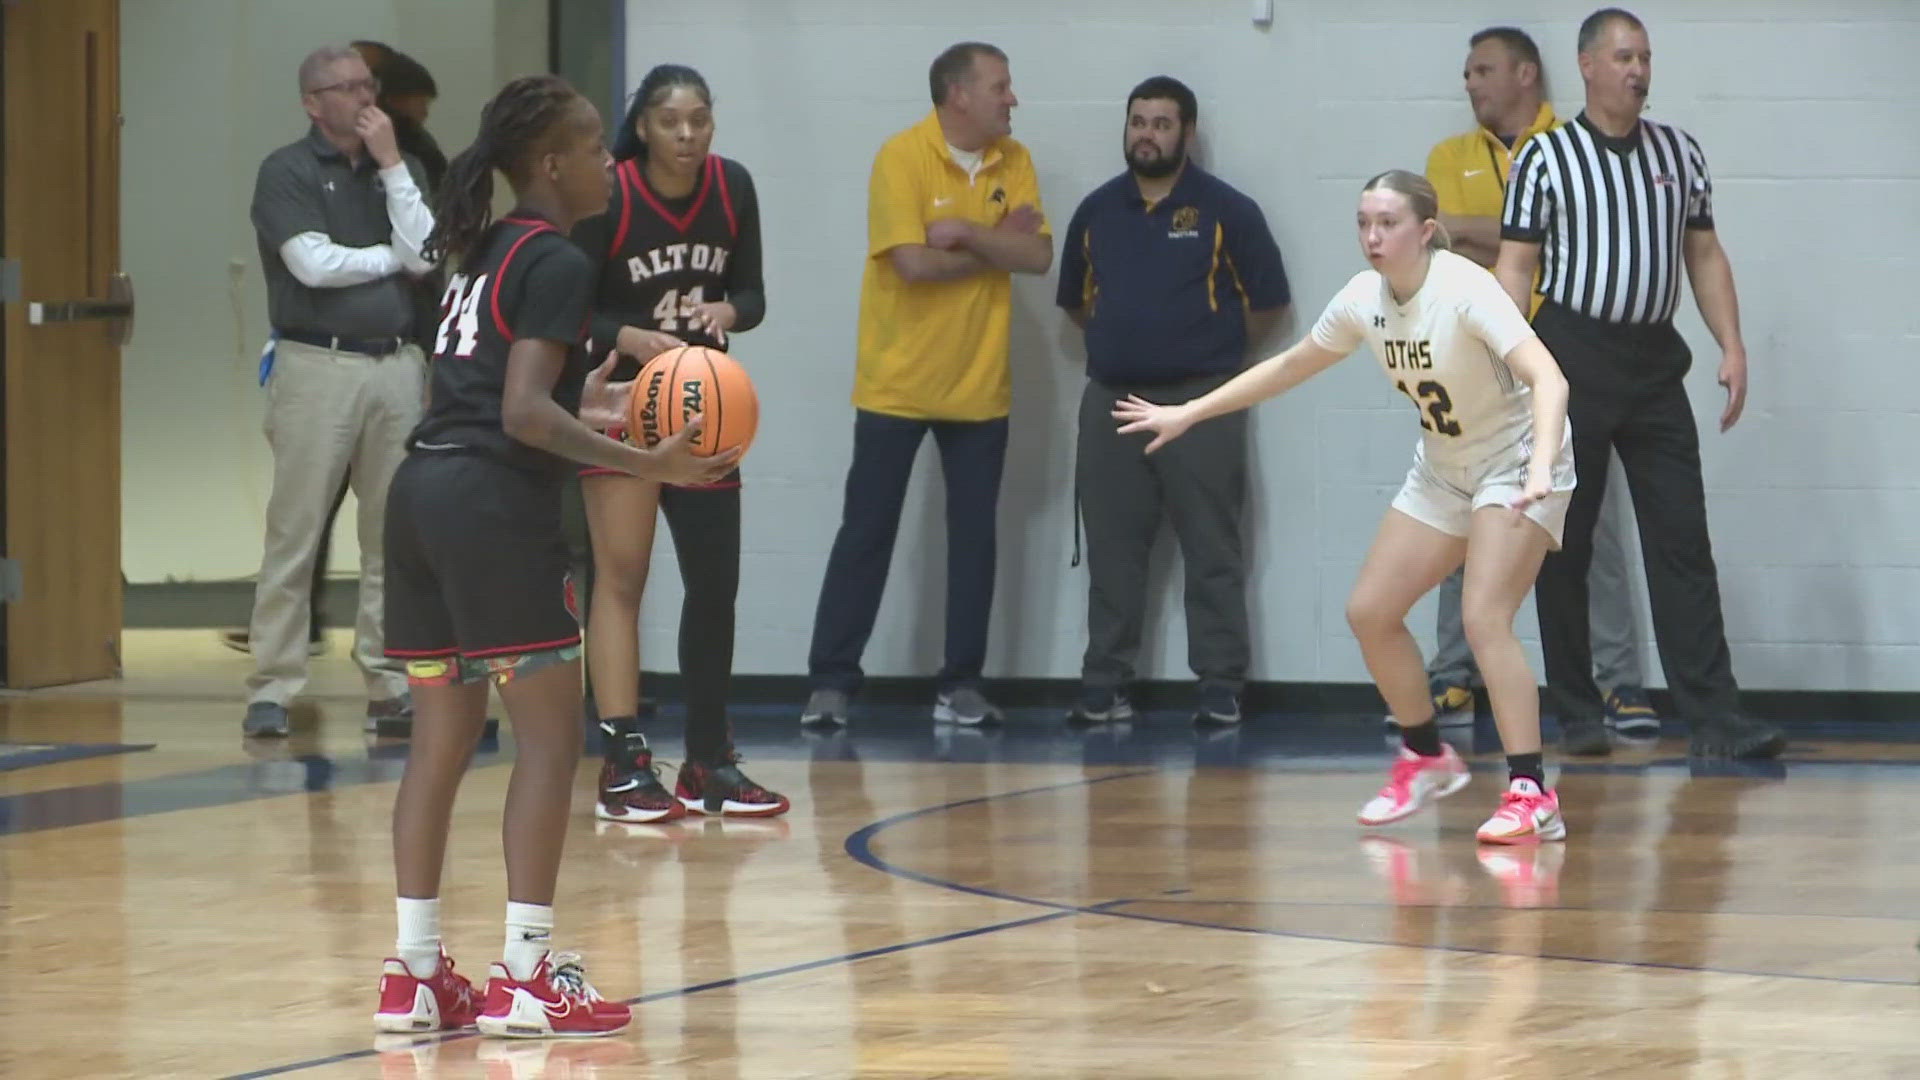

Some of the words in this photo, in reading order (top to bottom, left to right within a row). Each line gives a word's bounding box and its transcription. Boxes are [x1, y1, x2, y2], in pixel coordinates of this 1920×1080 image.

[627, 243, 729, 284] ALTON
[432, 272, 488, 359] 24
[653, 285, 705, 332] 44
[1384, 340, 1433, 369] OTHS
